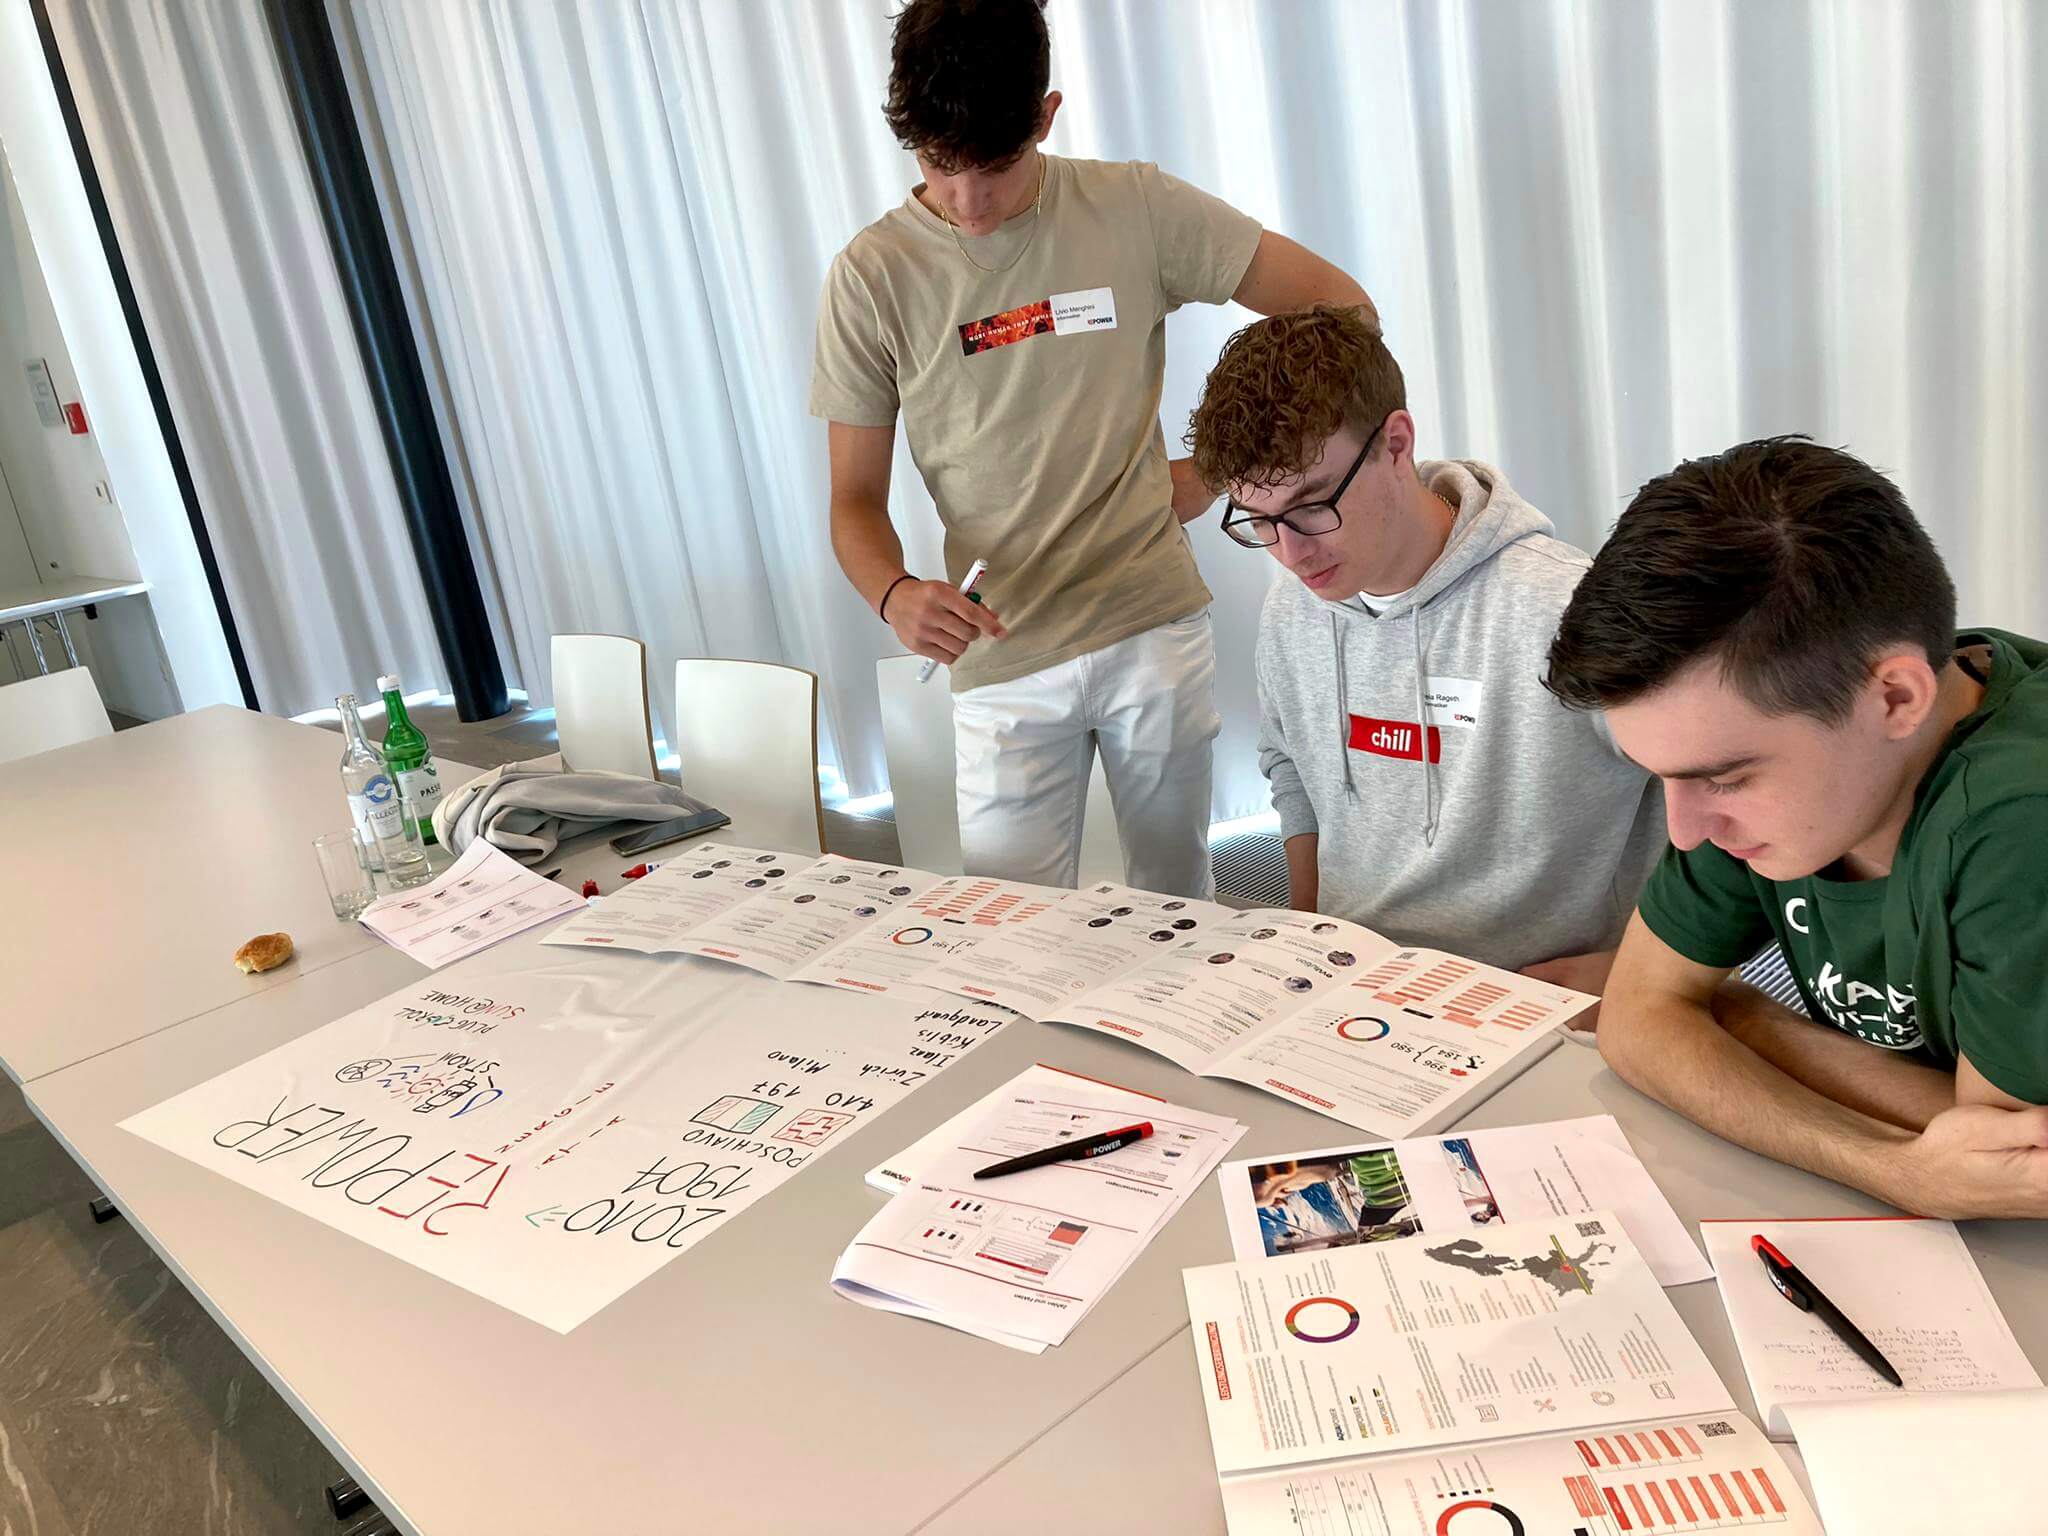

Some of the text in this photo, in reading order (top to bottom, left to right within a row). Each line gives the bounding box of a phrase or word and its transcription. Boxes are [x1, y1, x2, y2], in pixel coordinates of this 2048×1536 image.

[1371, 726, 1412, 752] chill
[914, 1009, 1003, 1035] Landquart
[916, 1029, 976, 1049] Küblis
[1390, 1042, 1414, 1054] 580
[908, 1046, 955, 1069] Ilanz
[1422, 1059, 1448, 1072] 396
[1437, 1049, 1462, 1060] 184
[766, 1049, 926, 1087] Zürich Milano
[750, 1080, 874, 1114] 410 197
[681, 1127, 814, 1169] POSCHIAVO
[619, 1156, 755, 1201] 1904
[562, 1197, 727, 1248] 2010
